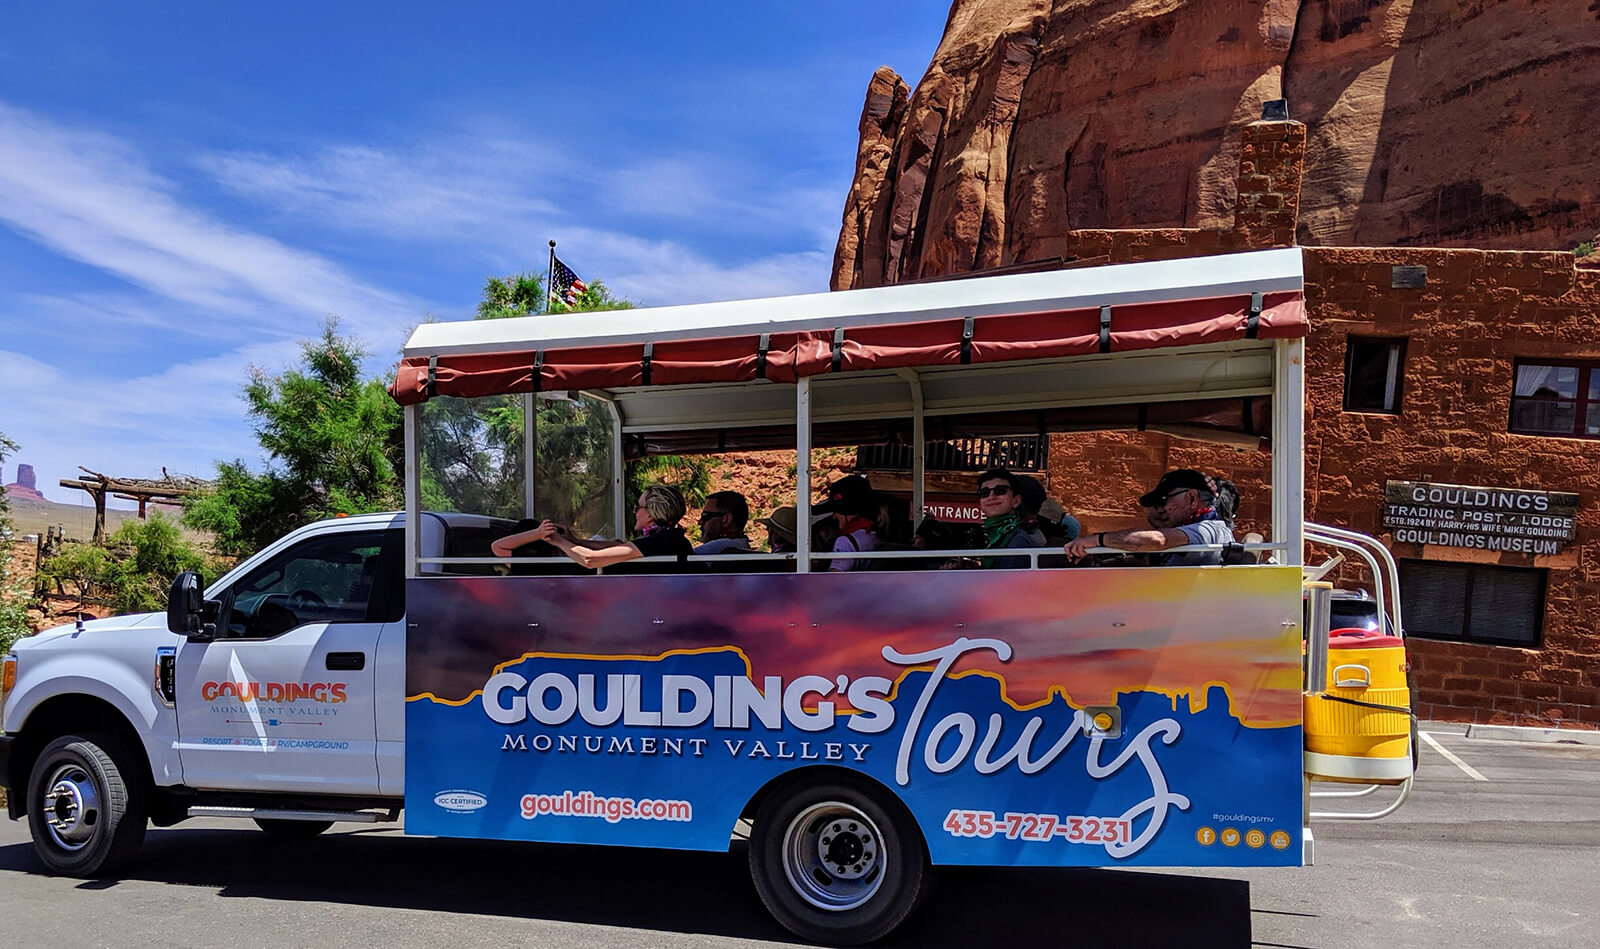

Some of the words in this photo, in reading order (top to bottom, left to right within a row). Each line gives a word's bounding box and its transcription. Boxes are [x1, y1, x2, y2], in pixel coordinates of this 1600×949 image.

[1413, 487, 1549, 511] GOULDING'S
[922, 505, 987, 520] ENTRANCE
[1389, 505, 1455, 520] TRADING
[1462, 510, 1504, 524] POST
[1522, 515, 1573, 529] LODGE
[1481, 523, 1502, 533] WIFE
[1396, 529, 1486, 548] GOULDING'S
[1488, 536, 1557, 555] MUSEUM
[202, 681, 347, 703] GOULDING'S
[482, 672, 895, 733] GOULDING'S
[210, 705, 284, 715] MONUMENT
[289, 707, 339, 716] VALLEY
[203, 737, 233, 746] RESORT
[278, 740, 349, 750] RV/CAMPGROUND
[501, 733, 707, 756] MONUMENT
[724, 739, 870, 761] VALLEY
[882, 637, 1190, 858] Tours
[521, 791, 692, 822] gouldings.com
[1213, 813, 1275, 823] #gouldingsmv
[945, 811, 1130, 843] 435-727-3231
